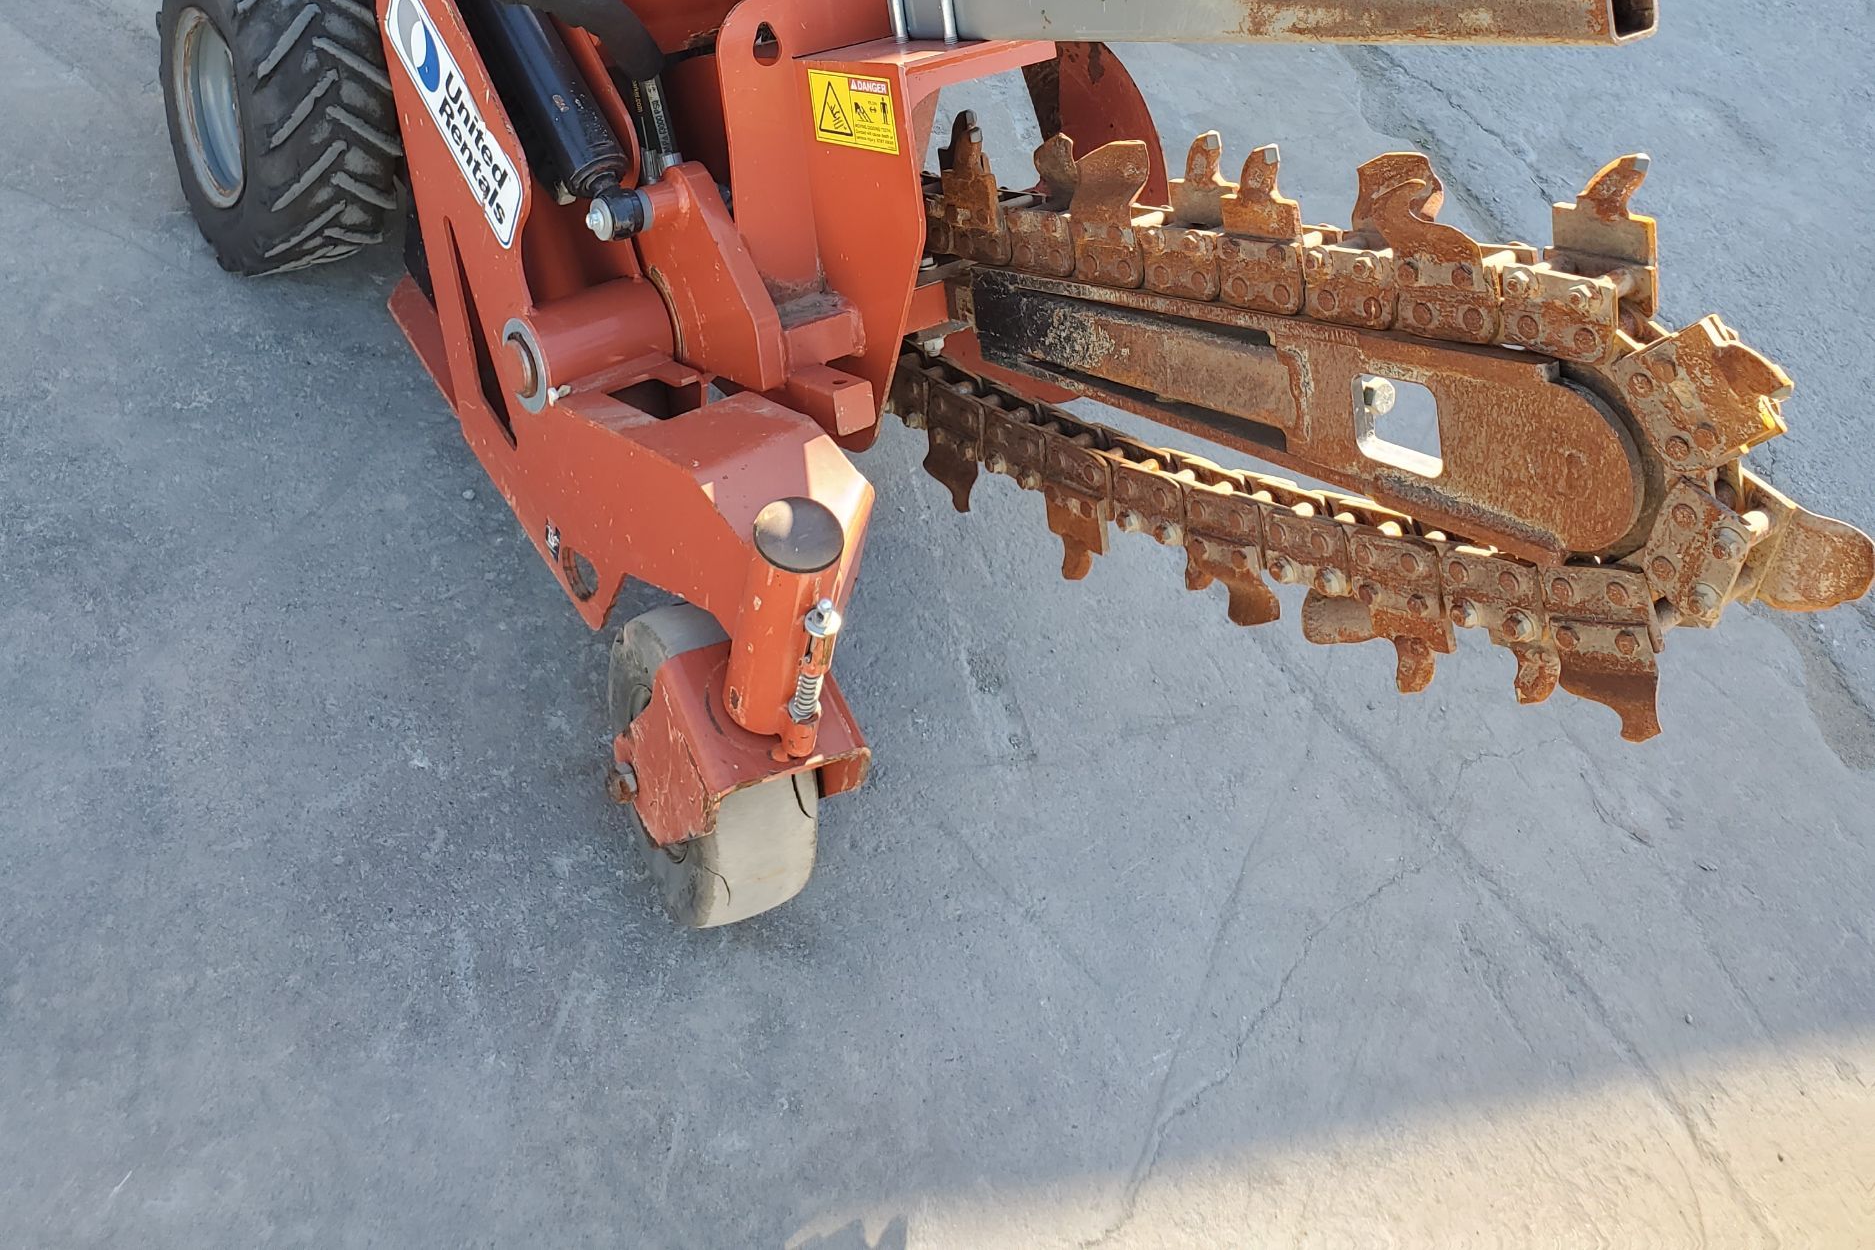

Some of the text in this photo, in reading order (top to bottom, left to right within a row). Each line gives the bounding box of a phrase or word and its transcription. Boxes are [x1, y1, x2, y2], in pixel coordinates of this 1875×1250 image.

[444, 71, 509, 186] United
[857, 81, 887, 94] DANGER
[438, 95, 505, 226] Rentals
